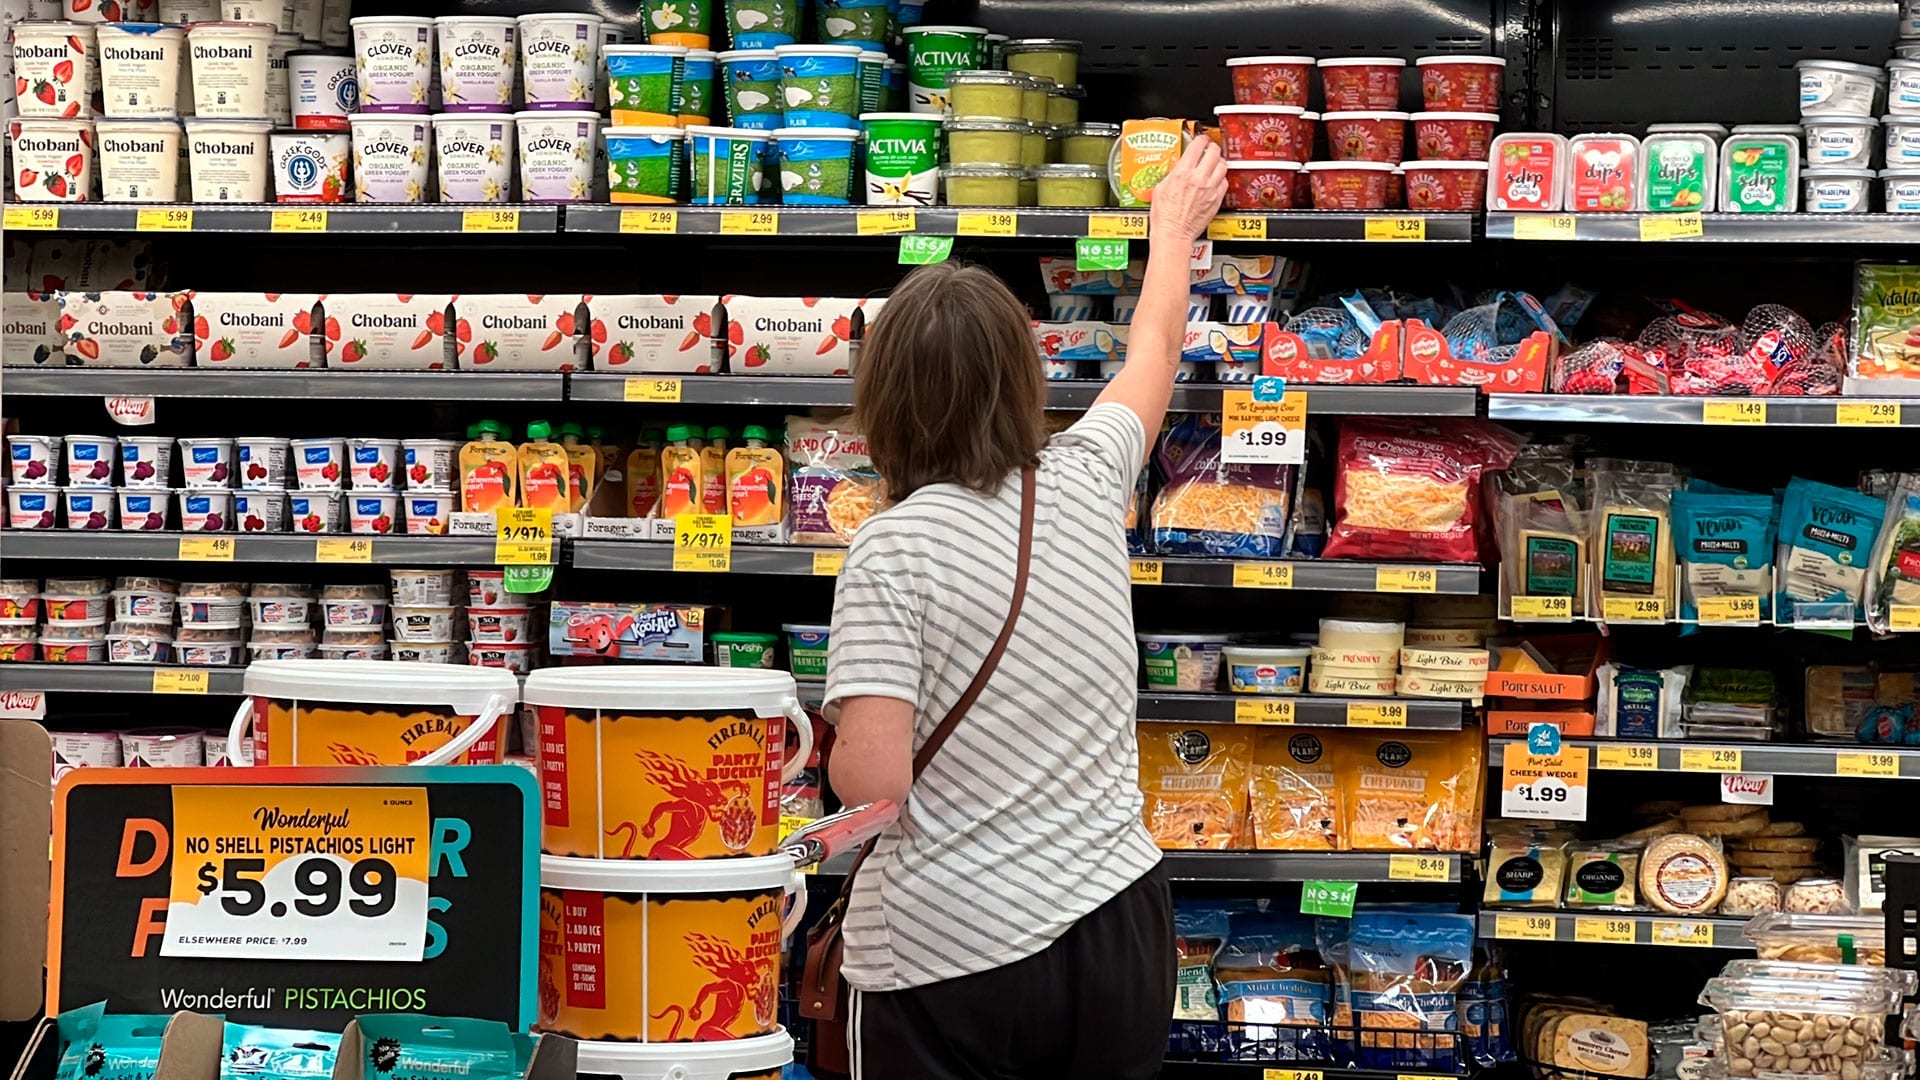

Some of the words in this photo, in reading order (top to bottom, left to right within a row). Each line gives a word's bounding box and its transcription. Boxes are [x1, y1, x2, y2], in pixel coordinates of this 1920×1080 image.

[14, 45, 68, 58] Chobani
[104, 47, 164, 61] Chobani
[194, 45, 252, 59] Chobani
[368, 43, 412, 58] CLOVER
[455, 43, 500, 57] CLOVER
[528, 41, 570, 55] CLOVER
[914, 52, 971, 66] ACTIVIA
[19, 139, 80, 152] Chobani
[104, 140, 164, 153] Chobani
[528, 139, 571, 153] CLOVER
[869, 139, 927, 154] ACTIVIA
[1128, 132, 1178, 147] WHOLLY
[1820, 136, 1854, 145] PHILADELPHIA
[194, 142, 254, 155] Chobani
[364, 142, 409, 156] CLOVER
[443, 142, 485, 156] CLOVER
[729, 143, 750, 204] GRAZIERS
[1506, 168, 1543, 188] dips
[1585, 162, 1622, 183] dips
[1657, 164, 1697, 184] dips
[1738, 171, 1777, 190] dips
[1817, 188, 1850, 197] PHILADELPHIA
[1080, 245, 1124, 255] NOSH
[220, 312, 284, 327] Chobani
[351, 313, 417, 328] Chobani
[482, 315, 547, 329] Chobani
[618, 315, 684, 329] Chobani
[755, 317, 822, 332] Chobani
[88, 321, 153, 335] Chobani
[1240, 432, 1287, 446] $1.99
[1354, 437, 1376, 450] Five
[1393, 437, 1444, 452] SHREDDED
[453, 520, 492, 533] Forager
[503, 526, 545, 541] 3/97¢
[587, 522, 627, 534] Forager
[212, 539, 229, 550] 49¢
[350, 541, 367, 551] 49¢
[680, 533, 724, 547] 3/97¢
[509, 567, 550, 578] NOSH
[688, 611, 699, 623] 12
[631, 616, 677, 640] Kool-Aid
[1416, 656, 1436, 667] Light
[1439, 656, 1462, 666] Brie
[1324, 680, 1345, 692] Light
[1348, 681, 1371, 691] Brie
[1429, 683, 1452, 694] Light
[1454, 684, 1474, 694] Brie
[1501, 681, 1528, 692] PORT
[1530, 682, 1563, 694] SALUT
[1505, 720, 1528, 731] POR
[707, 722, 765, 750] FIREBALL
[557, 744, 565, 754] ICE
[712, 754, 760, 767] PARTY
[706, 766, 764, 780] BUCKET
[1546, 770, 1578, 778] WEDGE
[1519, 787, 1567, 802] $1.99
[254, 807, 350, 835] Wonderful
[186, 837, 210, 854] NO
[215, 838, 264, 854] SHELL
[270, 838, 363, 854] PISTACHIOS
[369, 838, 415, 855] LIGHT
[1505, 871, 1534, 879] SHARP
[1581, 874, 1618, 882] ORGANIC
[197, 858, 398, 918] $5.99
[1307, 888, 1351, 901] NOSH
[573, 907, 587, 917] BUY
[574, 925, 588, 935] ADD
[589, 926, 600, 936] ICE
[178, 936, 243, 945] ELSEWHERE
[245, 937, 278, 945] PRICE:
[282, 937, 308, 946] $7.99
[574, 943, 600, 954] PARTY!
[1177, 968, 1205, 977] Blend
[284, 988, 426, 1010] PISTACHIOS
[402, 1057, 471, 1075] Wonderful
